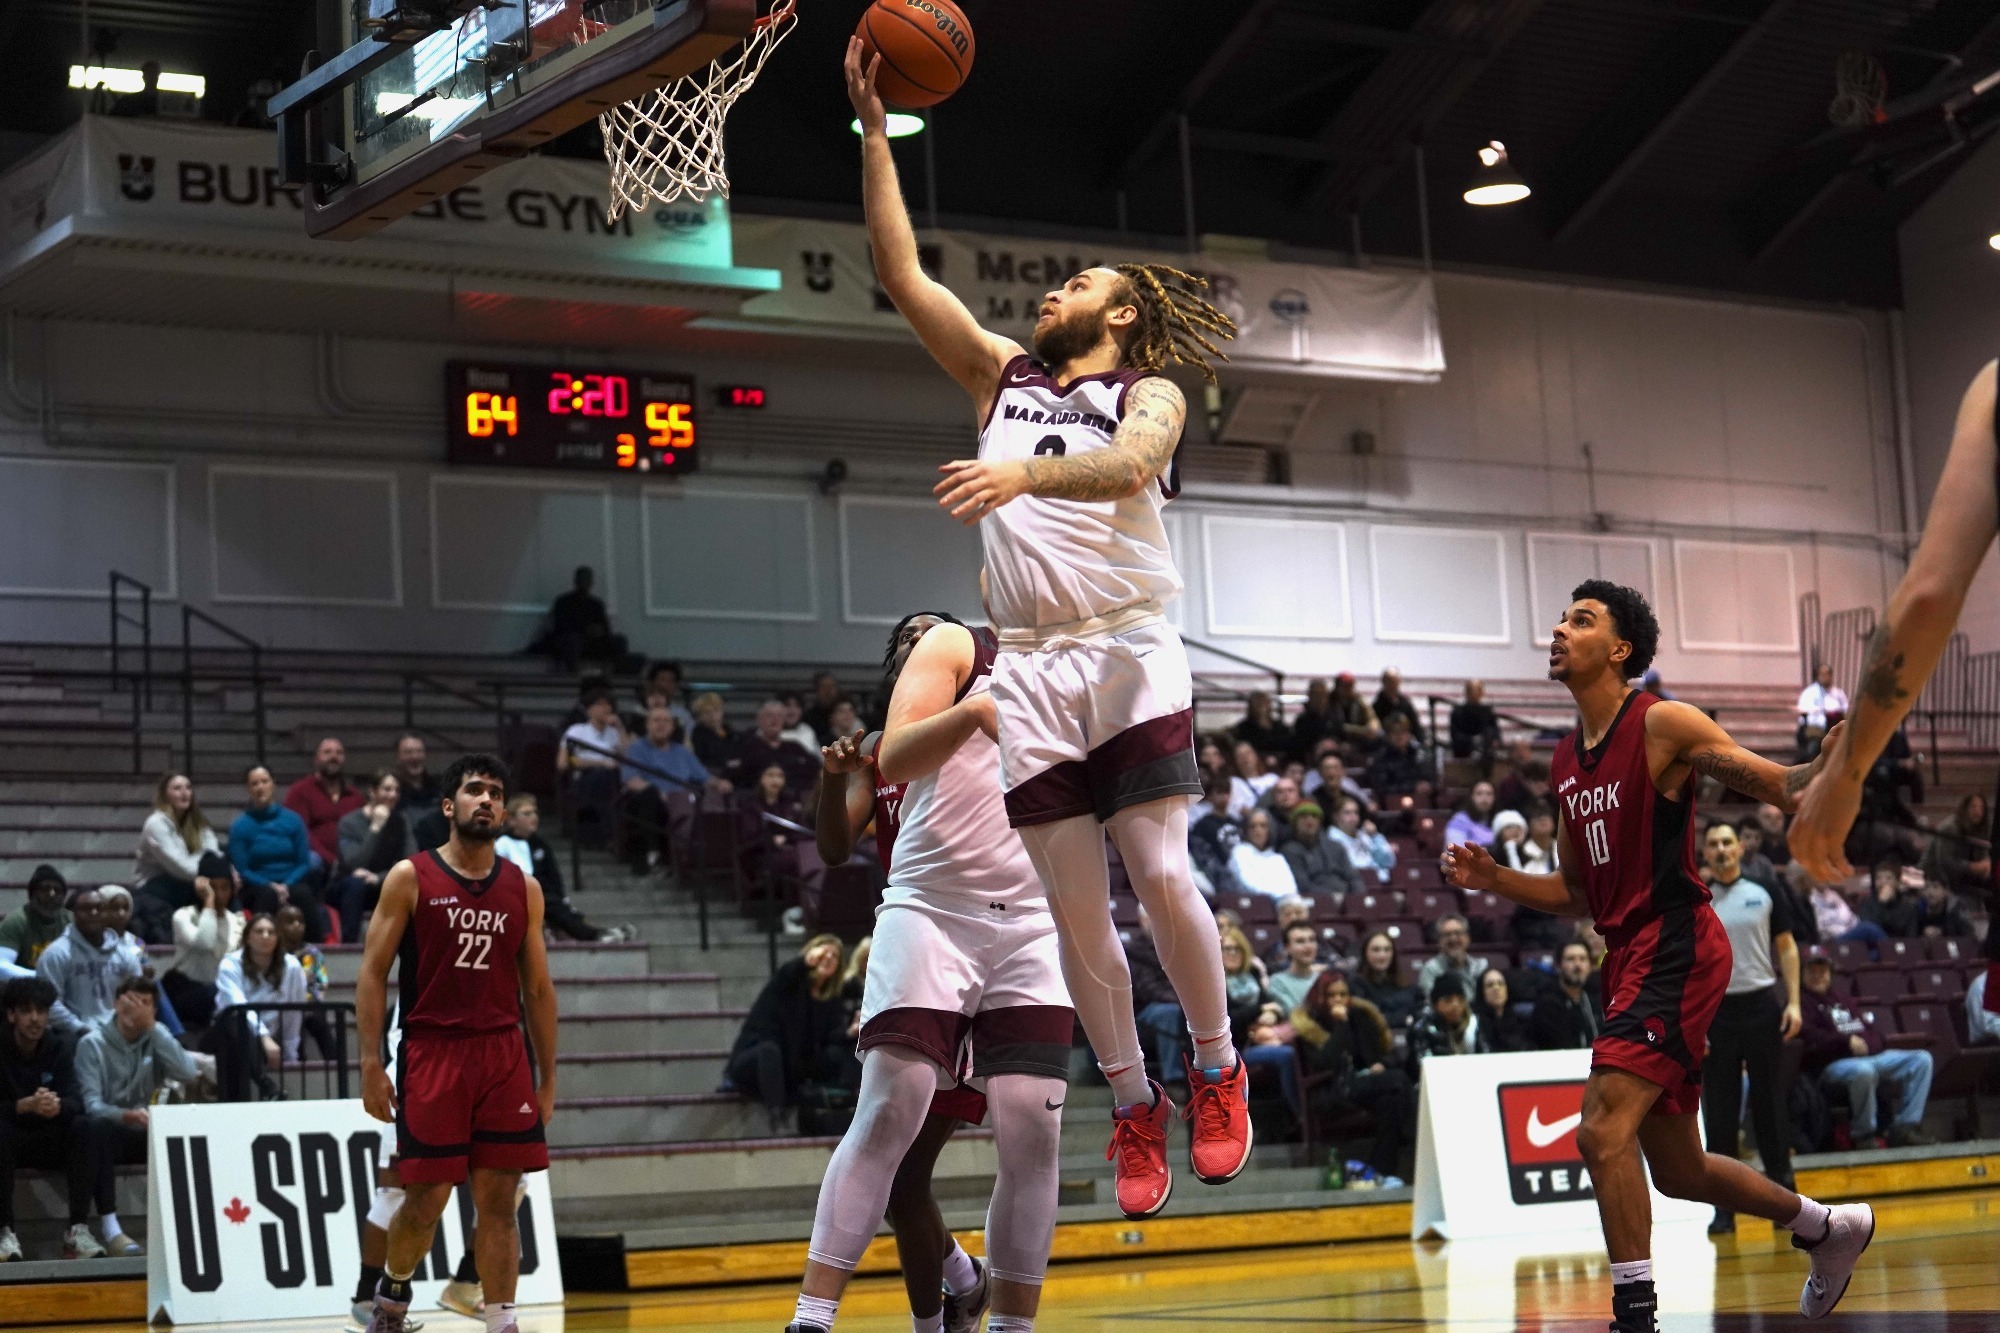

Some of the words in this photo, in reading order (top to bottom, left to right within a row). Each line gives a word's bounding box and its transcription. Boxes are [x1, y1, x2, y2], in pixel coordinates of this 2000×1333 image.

[178, 159, 487, 222] BURE
[507, 188, 634, 237] GYM
[466, 391, 518, 437] 64
[547, 371, 629, 418] 2:20
[645, 402, 694, 448] 55
[616, 432, 637, 468] 3
[1565, 781, 1621, 820] YORK
[1585, 818, 1611, 867] 10
[446, 907, 509, 934] YORK
[454, 932, 493, 970] 22
[1523, 1166, 1594, 1195] TEA
[166, 1135, 224, 1293] U
